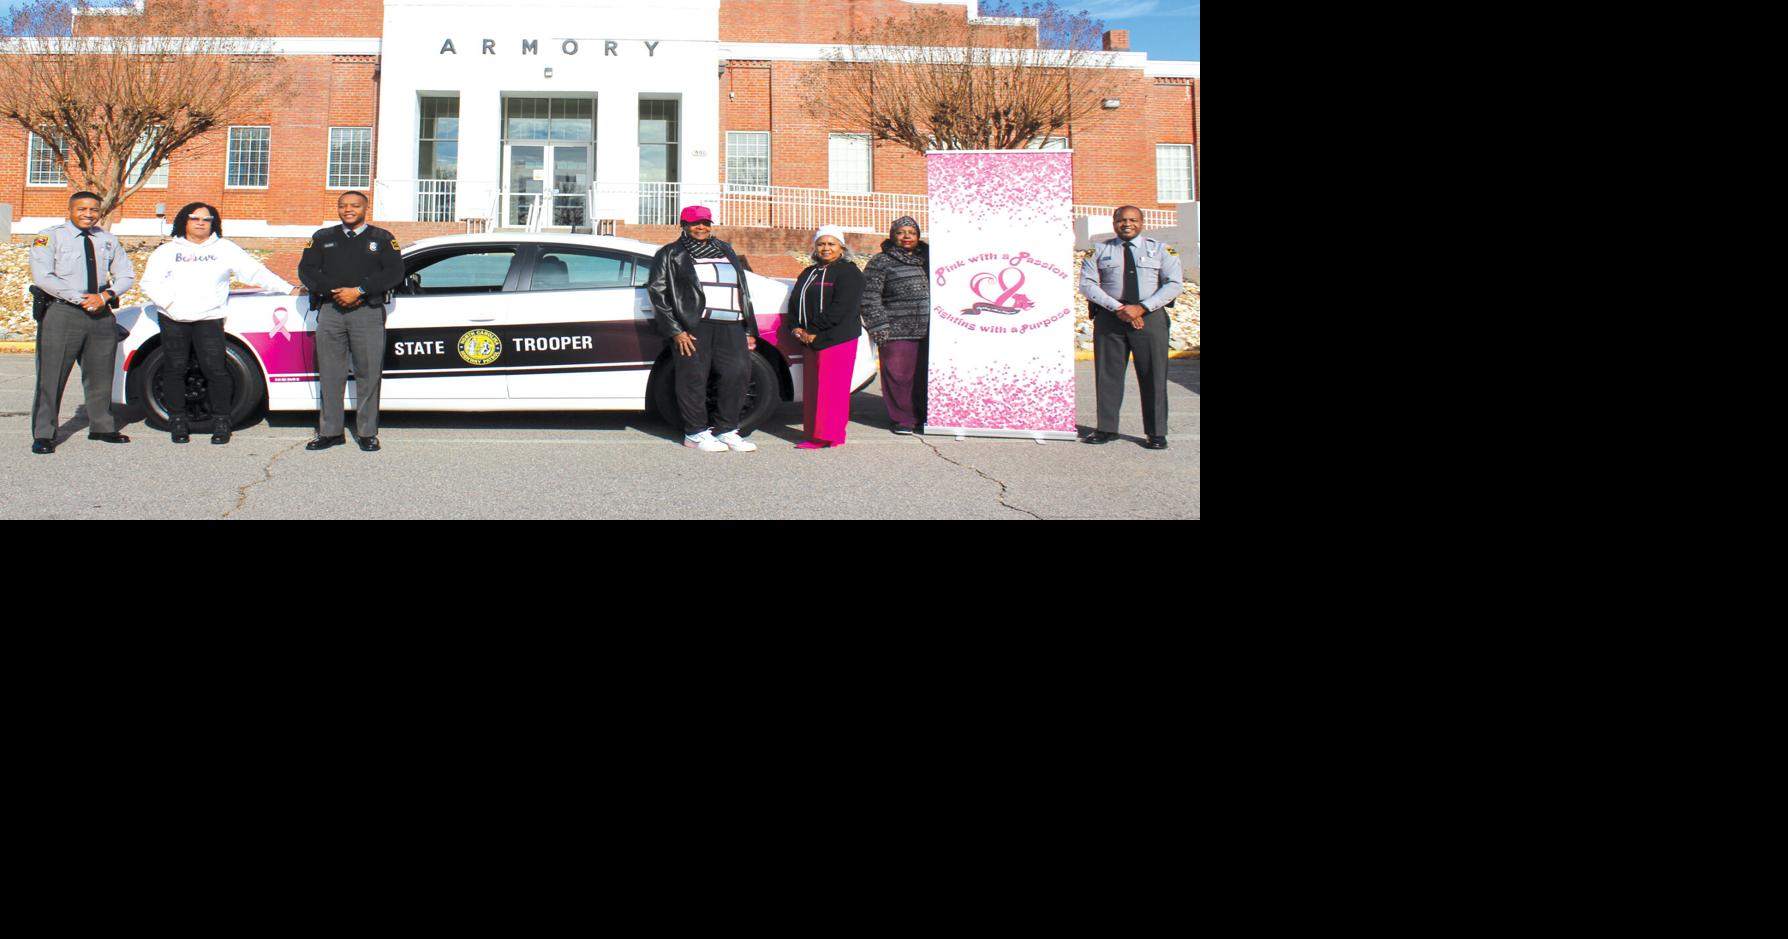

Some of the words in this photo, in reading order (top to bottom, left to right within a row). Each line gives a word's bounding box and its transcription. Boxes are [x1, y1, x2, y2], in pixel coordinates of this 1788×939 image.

[440, 38, 660, 57] ARMORY
[935, 260, 965, 286] Pink
[968, 253, 998, 263] with
[1009, 251, 1068, 279] Passion
[934, 305, 977, 331] Fighting
[980, 325, 1007, 334] with
[1019, 307, 1071, 334] Purpose
[394, 341, 445, 355] STATE
[512, 336, 593, 352] TROOPER
